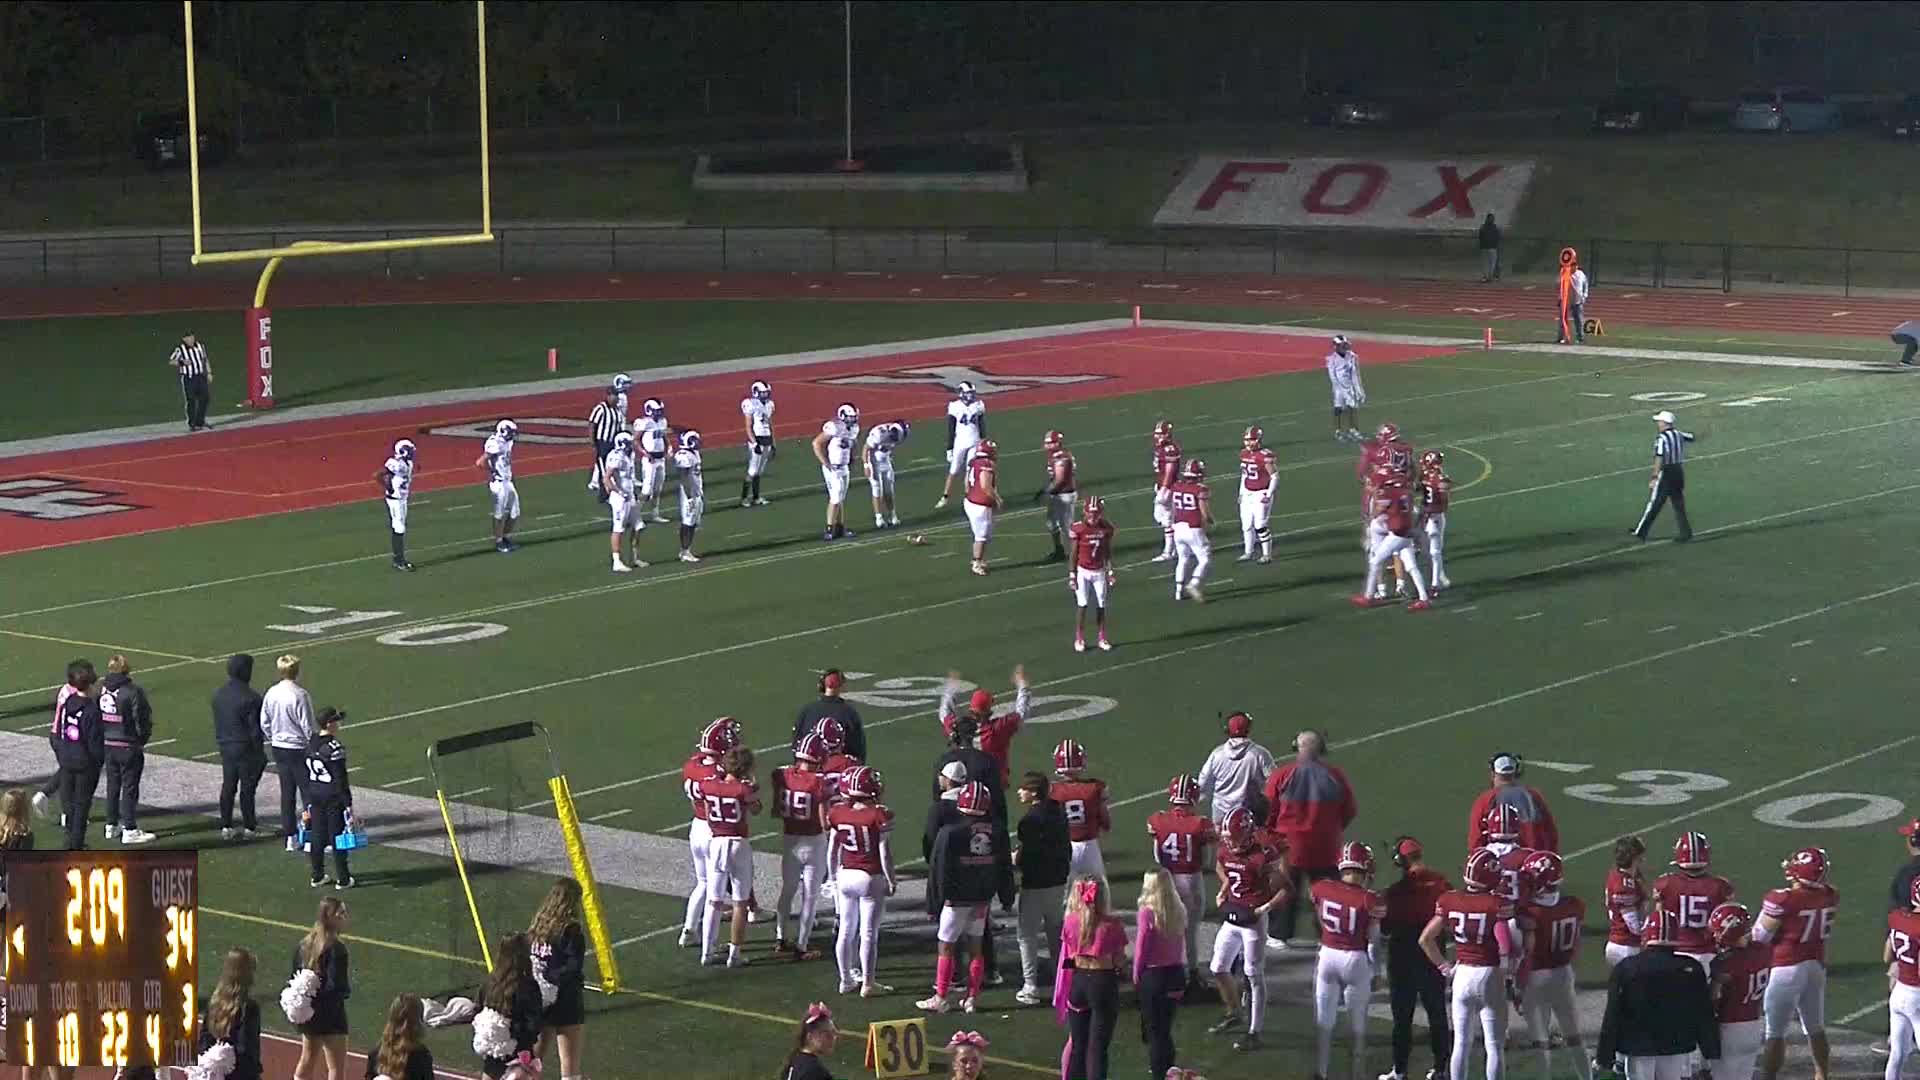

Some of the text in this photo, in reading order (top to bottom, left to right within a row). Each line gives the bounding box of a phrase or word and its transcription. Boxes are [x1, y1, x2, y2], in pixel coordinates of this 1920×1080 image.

[1195, 161, 1504, 218] FOX
[259, 317, 272, 397] FOX
[958, 413, 976, 425] 44
[1172, 492, 1196, 510] 59
[1089, 540, 1100, 558] 7
[265, 610, 510, 647] 10
[706, 795, 741, 823] 33
[1562, 768, 1905, 829] 30
[837, 824, 870, 853] 31
[1162, 832, 1192, 862] 41
[1227, 871, 1241, 898] 2
[1321, 900, 1357, 935] 51
[1448, 911, 1487, 944] 37
[1679, 895, 1708, 929] 15
[880, 1022, 923, 1072] 30
